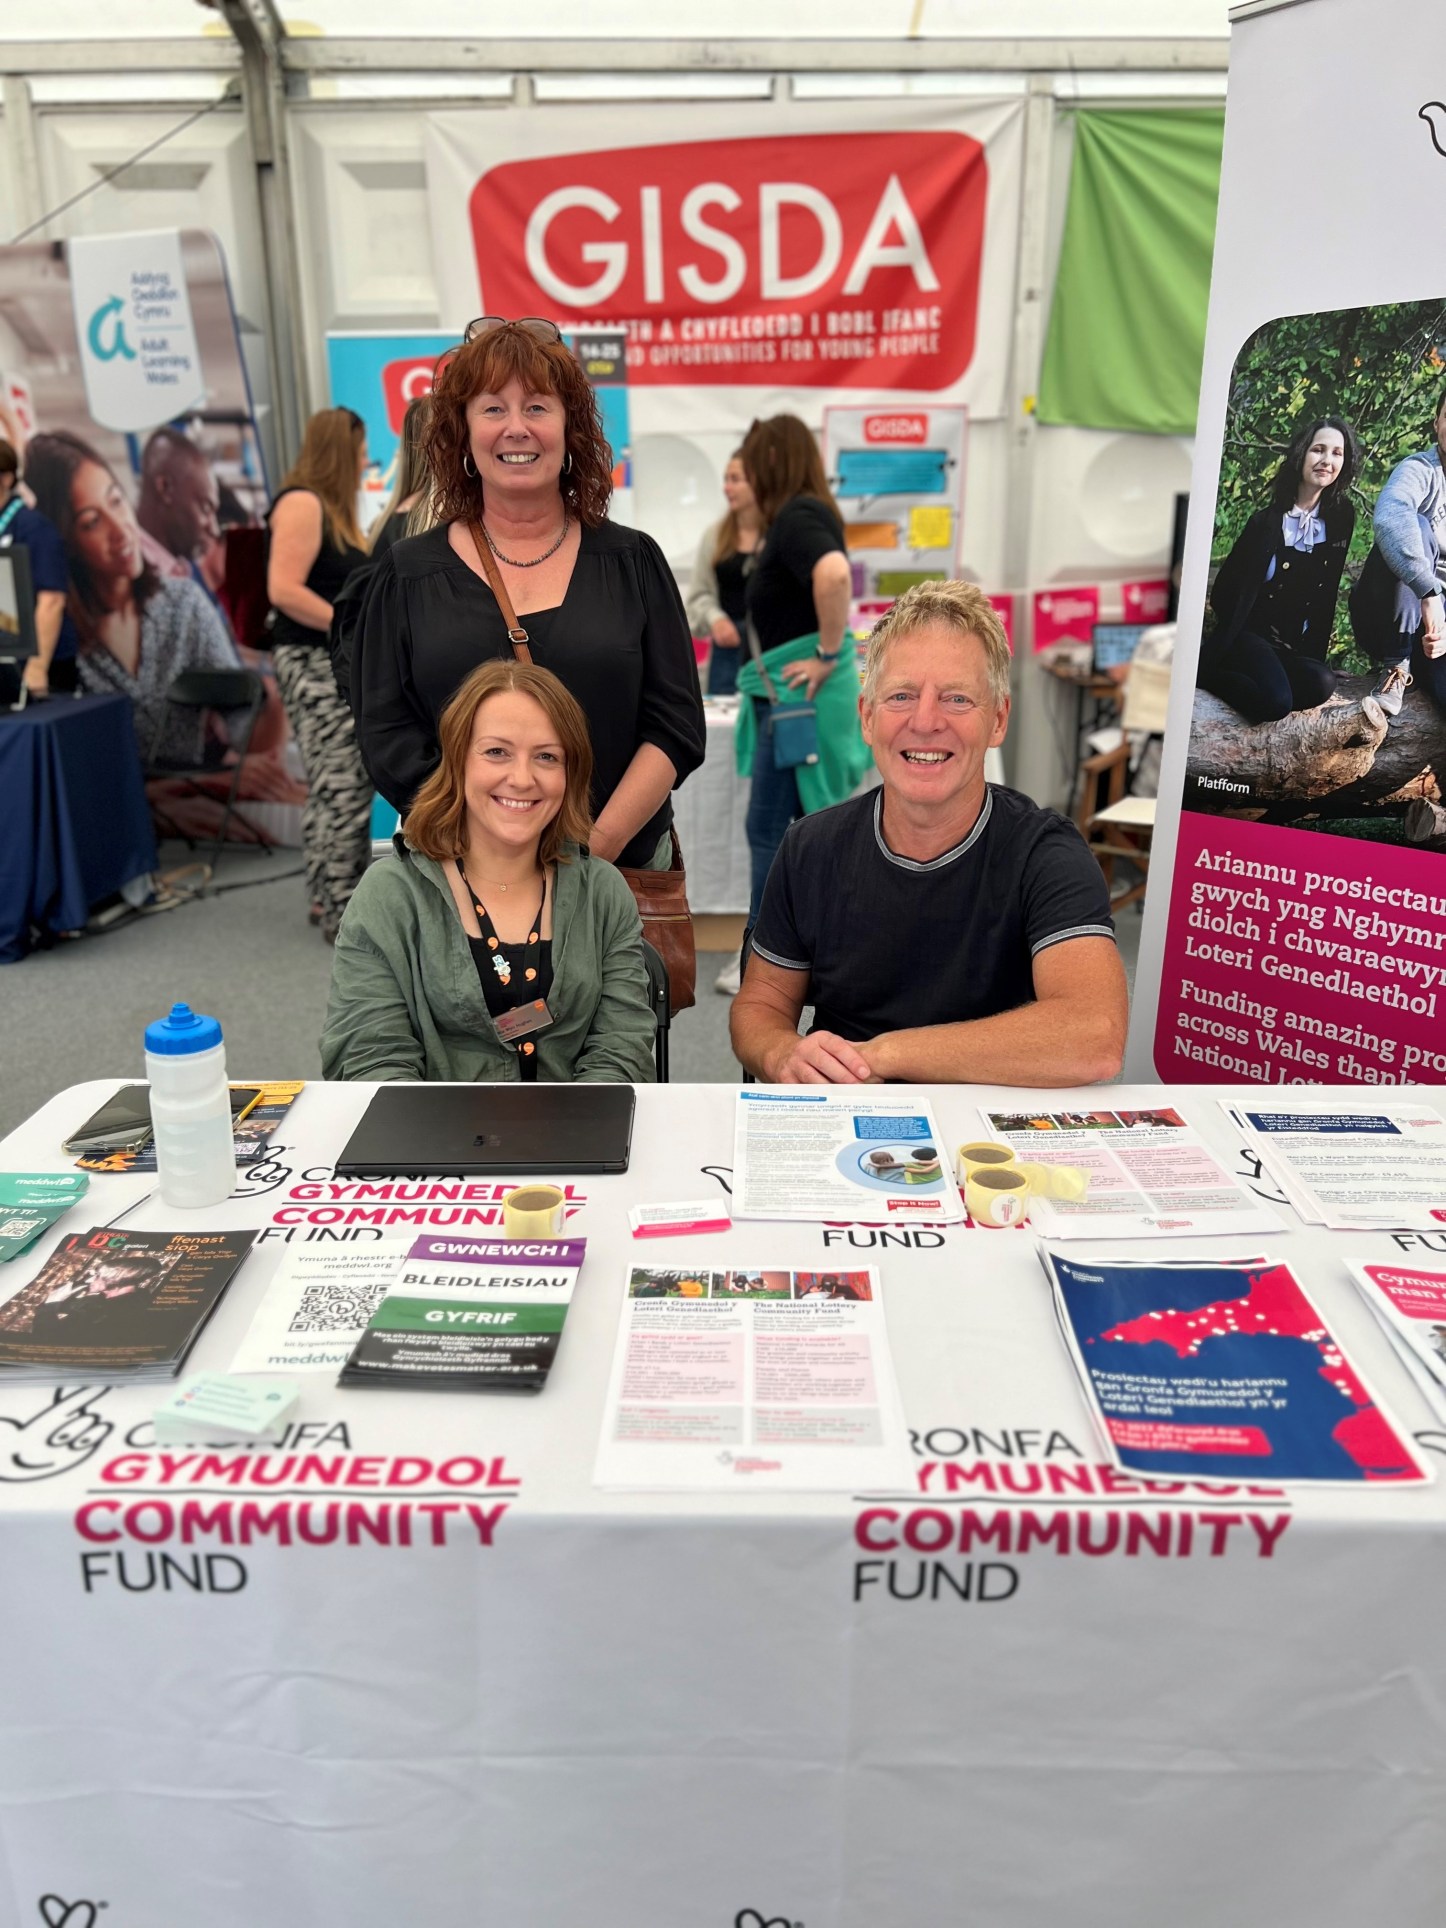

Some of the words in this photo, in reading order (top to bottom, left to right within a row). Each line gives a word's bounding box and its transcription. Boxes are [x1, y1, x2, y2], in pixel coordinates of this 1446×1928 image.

[525, 173, 941, 306] GISDA
[660, 319, 675, 340] A
[680, 312, 803, 340] CHYFLEOEDD
[811, 312, 820, 336] I
[827, 310, 876, 336] BOBL
[883, 305, 942, 333] IFANC
[651, 340, 777, 367] OPPORTUNITIES
[781, 339, 814, 362] FOR
[818, 336, 876, 360] YOUNG
[879, 332, 940, 357] PEOPLE
[867, 417, 925, 439] GISDA
[1197, 776, 1250, 794] Platfform
[1194, 848, 1297, 886] Ariannu
[1303, 876, 1446, 916] prosiectau
[1190, 881, 1270, 912] gwych
[1277, 898, 1327, 930] yng
[1188, 907, 1261, 942] diolch
[1268, 923, 1277, 945] i
[1185, 936, 1253, 970] Loteri
[1260, 955, 1437, 1018] Genedlaethol
[1180, 979, 1278, 1028] Funding
[1283, 1008, 1398, 1063] amazing
[1403, 1044, 1446, 1074] pro
[1177, 1011, 1250, 1045] across
[1256, 1029, 1330, 1069] Wales
[1173, 1036, 1271, 1083] National
[15, 1177, 62, 1186] meddwl
[288, 1183, 588, 1201] GYMUNEDL
[171, 1235, 227, 1244] ffenast
[256, 1226, 384, 1244] FUND
[823, 1230, 946, 1249] FUND
[165, 1243, 200, 1252] siop
[428, 1242, 560, 1257] GWNEWCH
[560, 1245, 569, 1257] I
[402, 1273, 568, 1288] BLEIDLEISIAU
[1388, 1286, 1439, 1299] man
[425, 1310, 518, 1325] GYFRIF
[408, 1333, 440, 1341] system
[358, 1360, 538, 1373] www.makevotesmatter.org.uk
[1091, 1369, 1167, 1386] Prosiectau
[1170, 1377, 1218, 1387] wedi'u
[1221, 1378, 1288, 1388] hariannu
[1096, 1381, 1122, 1392] gan
[1124, 1383, 1174, 1395] Gronfa
[1177, 1387, 1261, 1398] Gymunedol
[1264, 1388, 1274, 1398] y
[1100, 1391, 1144, 1403] Loteri
[1146, 1394, 1246, 1408] Genedlaethol
[1249, 1399, 1269, 1410] yn
[1272, 1398, 1288, 1410] yr
[1103, 1402, 1142, 1414] ardal
[1144, 1406, 1174, 1416] leol
[908, 1427, 1084, 1458] RONFA
[100, 1453, 521, 1487] GYMUNEDOL
[918, 1461, 1286, 1497] YMUNE
[74, 1500, 509, 1547] COMMUNITY
[853, 1508, 1292, 1558] COMMUNITY
[79, 1550, 248, 1594] FUND
[852, 1560, 1020, 1602] FUND
